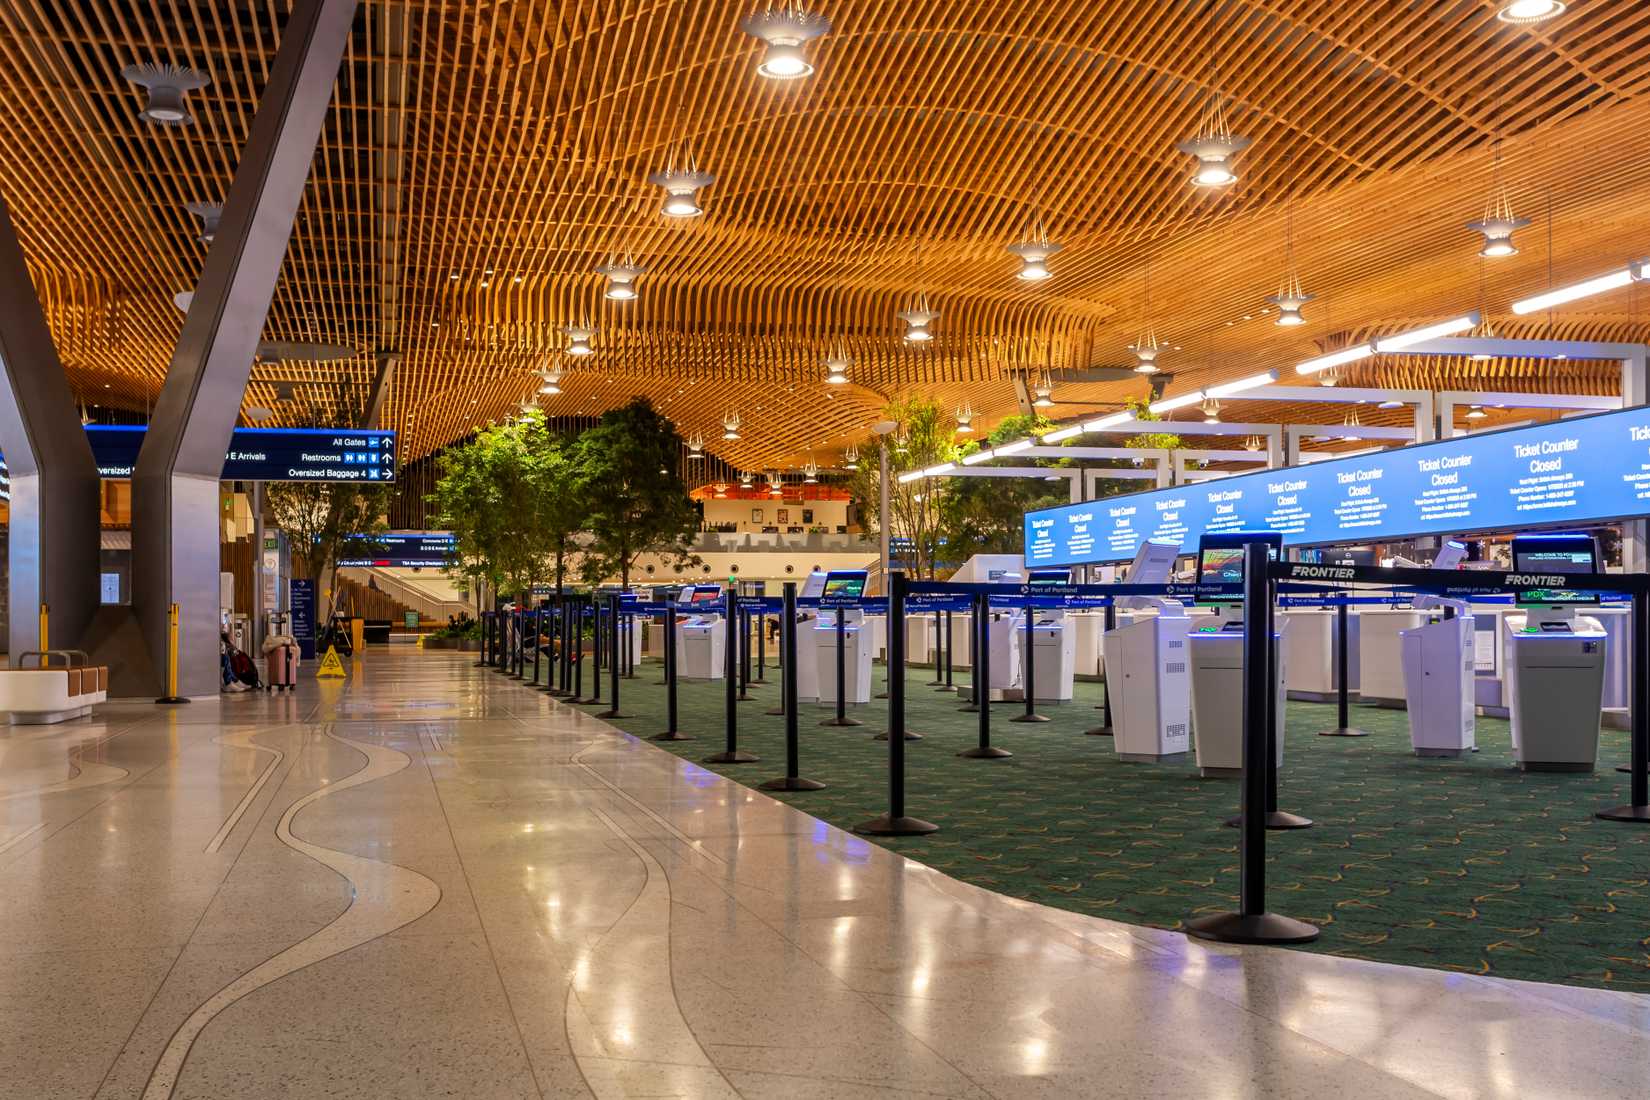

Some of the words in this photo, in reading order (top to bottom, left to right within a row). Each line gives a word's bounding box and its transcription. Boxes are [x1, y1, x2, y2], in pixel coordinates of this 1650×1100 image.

[332, 438, 343, 447] All
[343, 438, 366, 447] Gates
[1514, 443, 1541, 459] Ticket
[1542, 438, 1579, 455] Counter
[237, 452, 266, 461] Arrivals
[301, 454, 341, 462] Restrooms
[1418, 459, 1441, 472] Ticket
[1440, 454, 1474, 470] Counter
[1530, 457, 1563, 474] Closed
[288, 469, 325, 477] Oversized
[326, 469, 359, 479] Baggage
[360, 469, 366, 477] 4
[1338, 470, 1357, 483] Ticket
[1356, 468, 1384, 481] Counter
[1431, 471, 1458, 486] Closed
[1268, 483, 1286, 494] Ticket
[1285, 480, 1308, 492] Counter
[1348, 485, 1372, 497] Closed
[1277, 495, 1299, 506] Closed
[1291, 566, 1356, 579] FRONTIER
[1504, 575, 1567, 587] FRONTIER
[1031, 586, 1044, 594] Port
[1052, 586, 1078, 594] Portland
[1197, 585, 1222, 593] Portland
